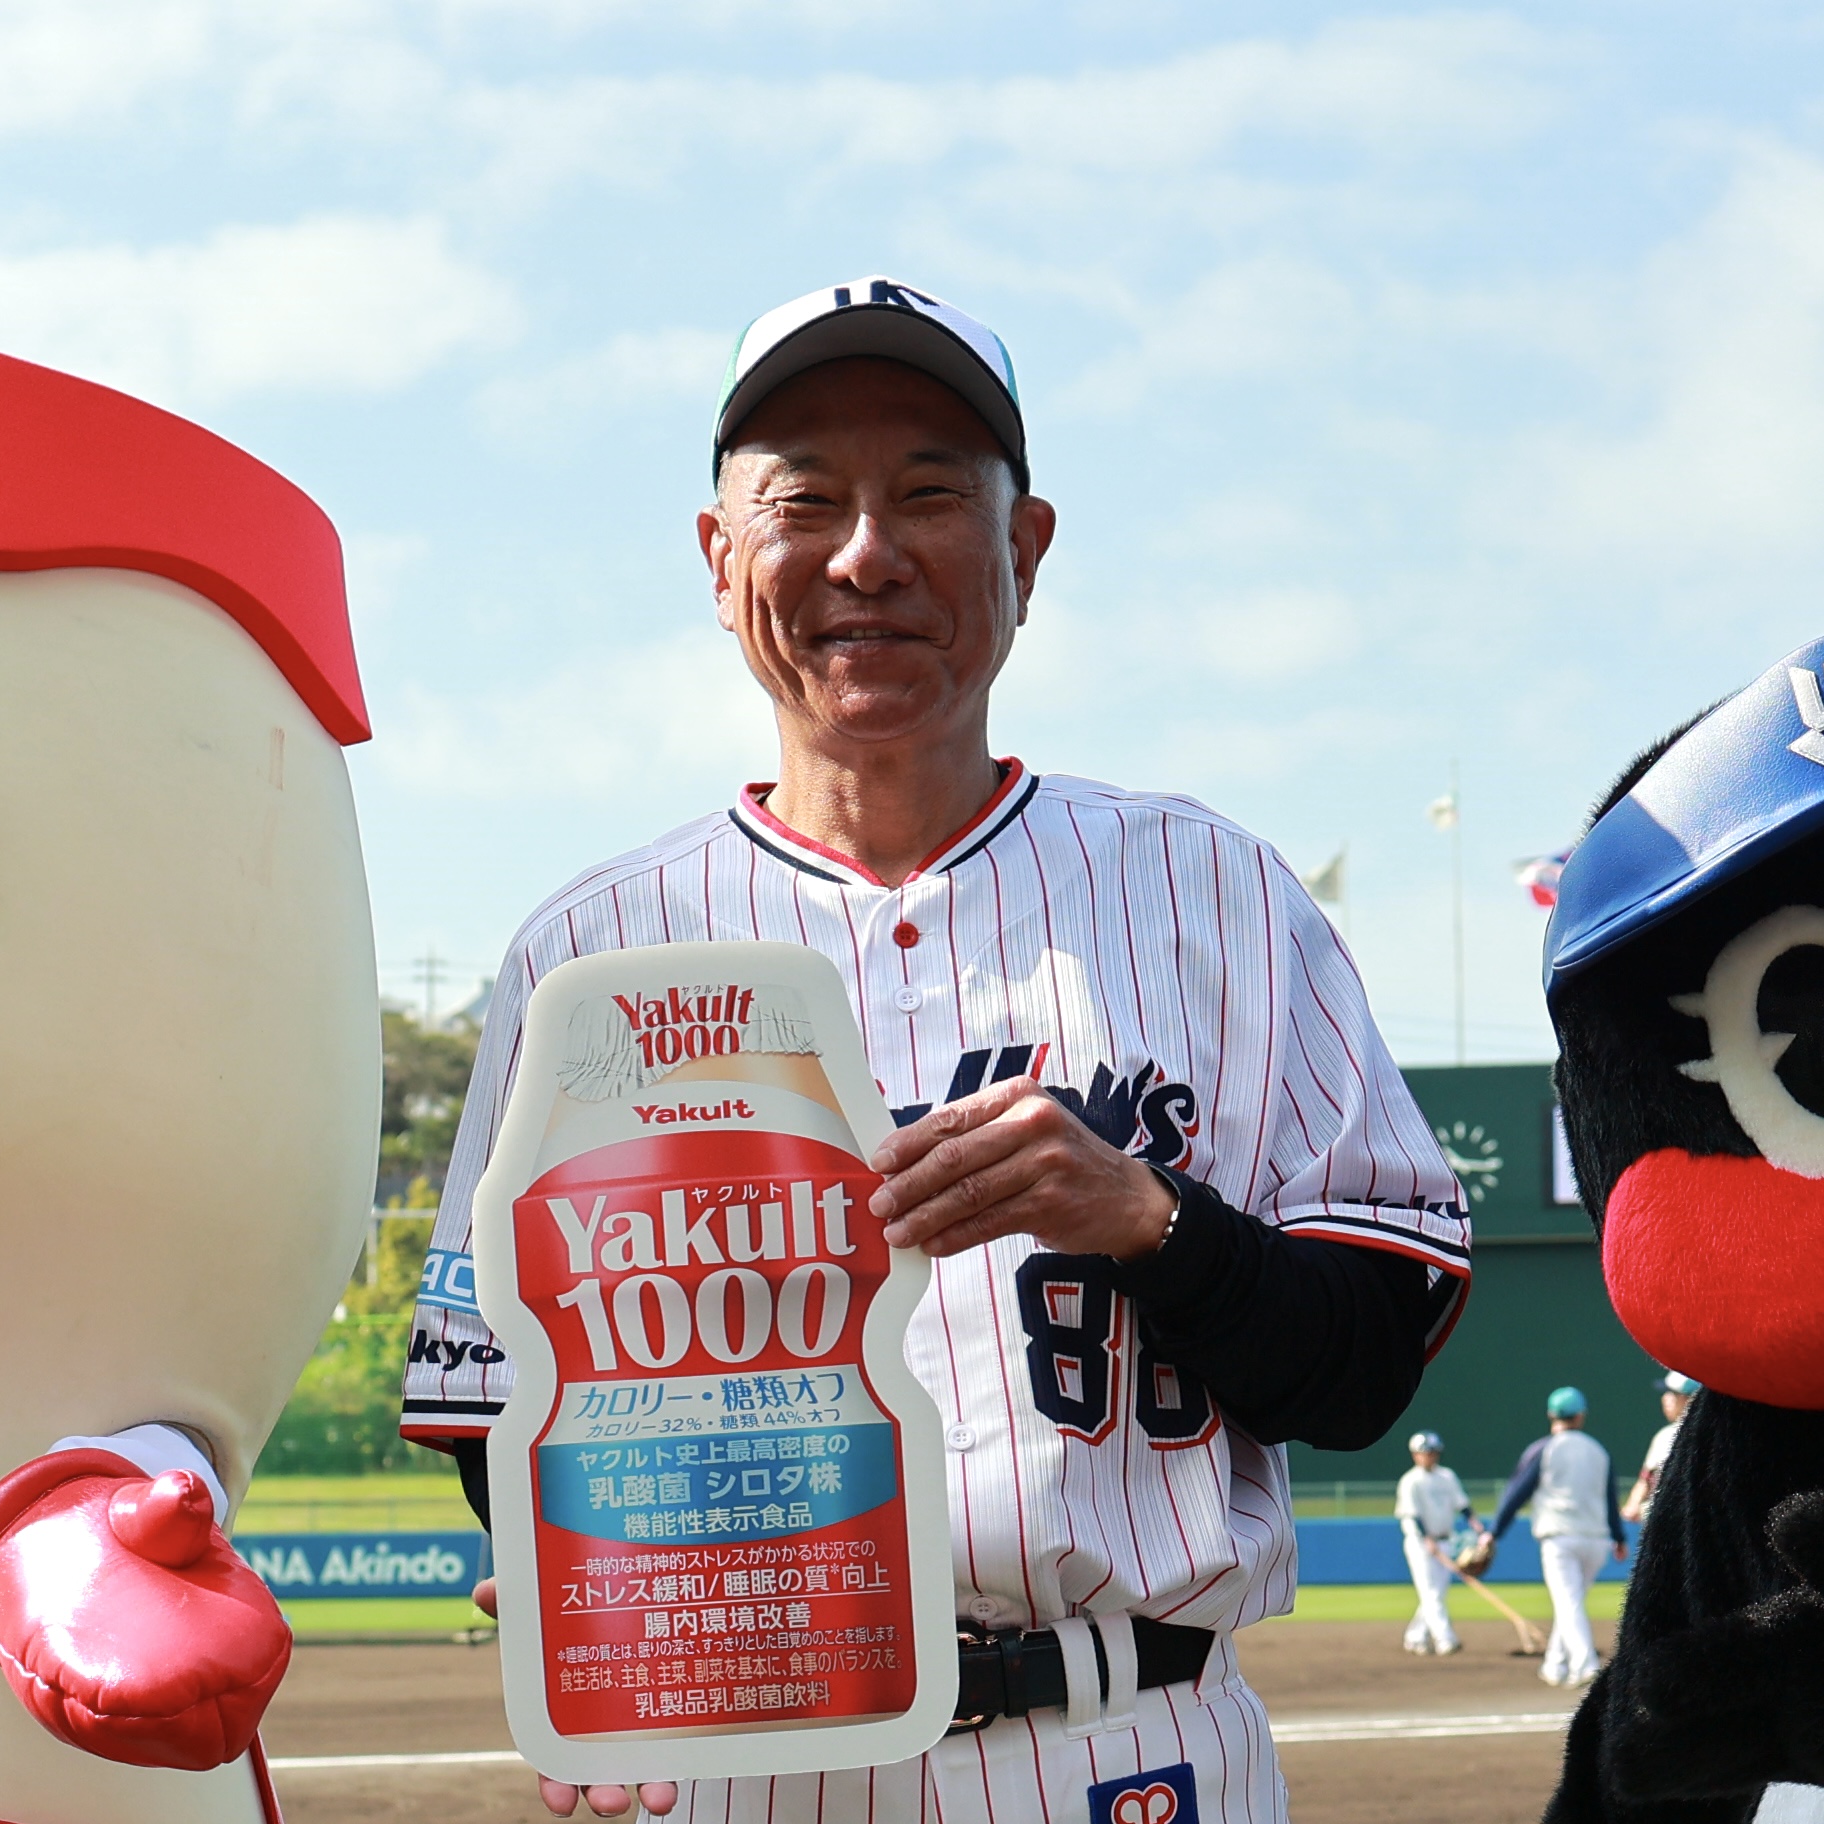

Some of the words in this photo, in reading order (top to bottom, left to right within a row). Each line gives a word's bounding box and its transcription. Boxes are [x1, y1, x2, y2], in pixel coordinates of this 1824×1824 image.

[611, 984, 755, 1031] Yakult
[681, 984, 725, 996] ヤクルト
[635, 1024, 741, 1069] 1000
[632, 1098, 756, 1125] Yakult
[691, 1182, 783, 1204] ヤクルト
[545, 1180, 857, 1274] Yakult
[555, 1262, 851, 1371] 1000
[574, 1373, 845, 1419] カロリー・糖類オフ
[576, 1434, 851, 1473] ヤクルト史上最高密度の
[624, 1502, 814, 1540] 機能性表示食品
[238, 1547, 314, 1585] NA
[320, 1541, 466, 1585] Akindo
[570, 1540, 876, 1577] 一時的な精神的ストレスがかかる状況での
[644, 1602, 812, 1640] 腸内環境改善
[635, 1680, 831, 1719] 乳製品乳酸菌飲料
